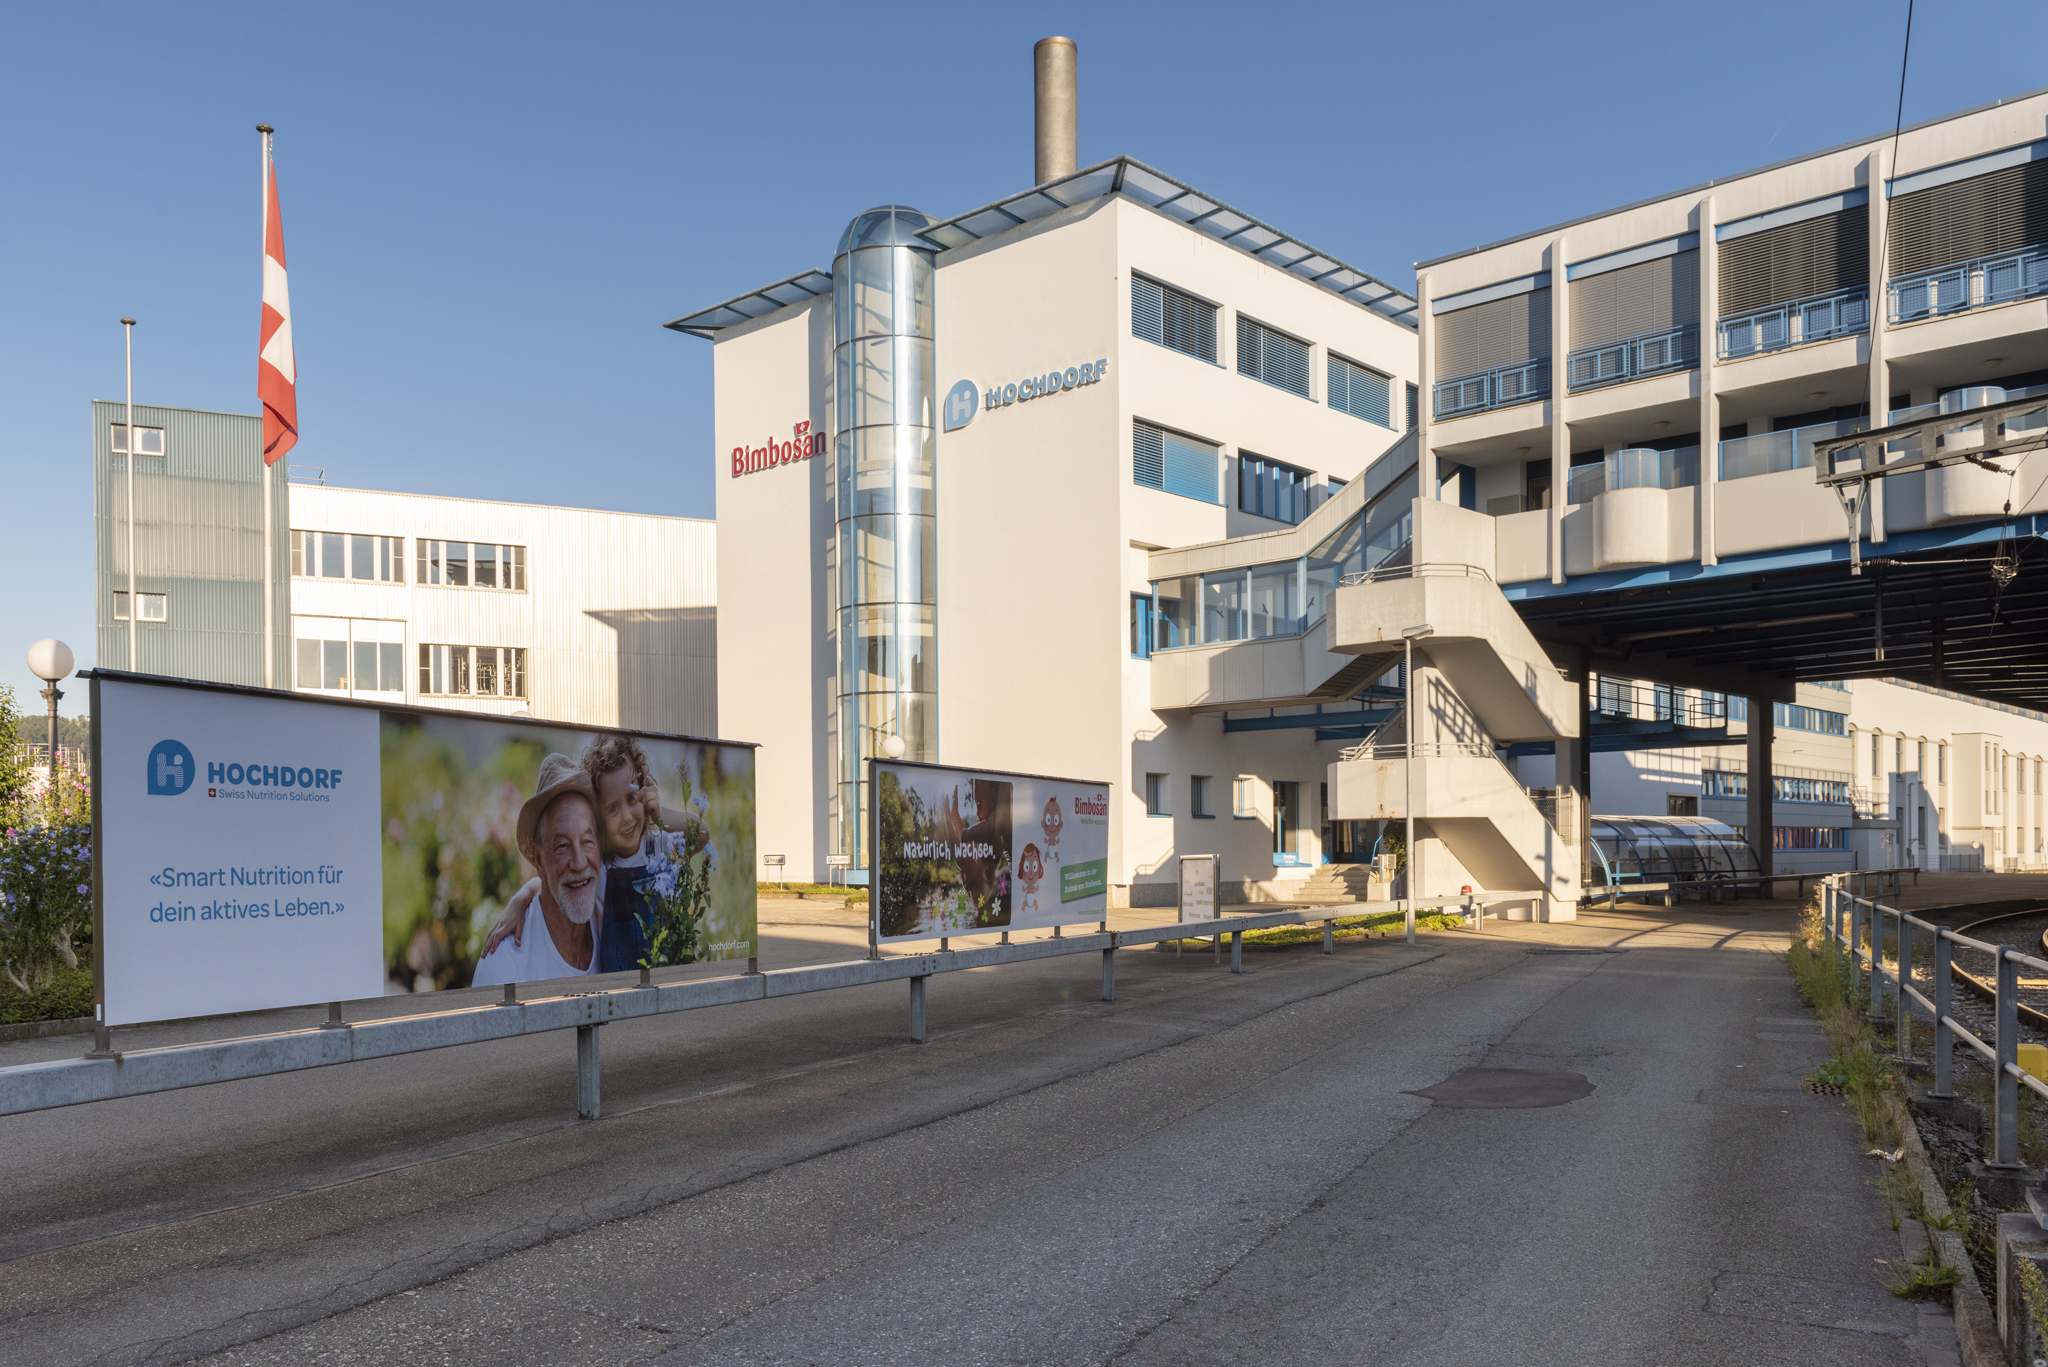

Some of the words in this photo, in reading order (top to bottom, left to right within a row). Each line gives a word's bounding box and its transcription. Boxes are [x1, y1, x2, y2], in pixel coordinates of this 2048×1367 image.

[987, 358, 1108, 408] HOCHDORF
[732, 430, 827, 476] Bimbosan
[207, 761, 343, 790] HOCHDORF
[218, 788, 246, 799] Swiss
[247, 790, 288, 801] Nutrition
[290, 792, 330, 803] Solutions
[1074, 796, 1108, 817] Bimbosan
[903, 836, 951, 861] Natürlich
[953, 840, 996, 860] wachsen.
[150, 867, 226, 888] «Smart
[230, 866, 314, 886] Nutrition
[317, 865, 343, 884] für
[150, 901, 196, 923] dein
[200, 899, 270, 921] aktives
[274, 897, 345, 917] Leben.»
[708, 940, 750, 951] hochdorf.com
